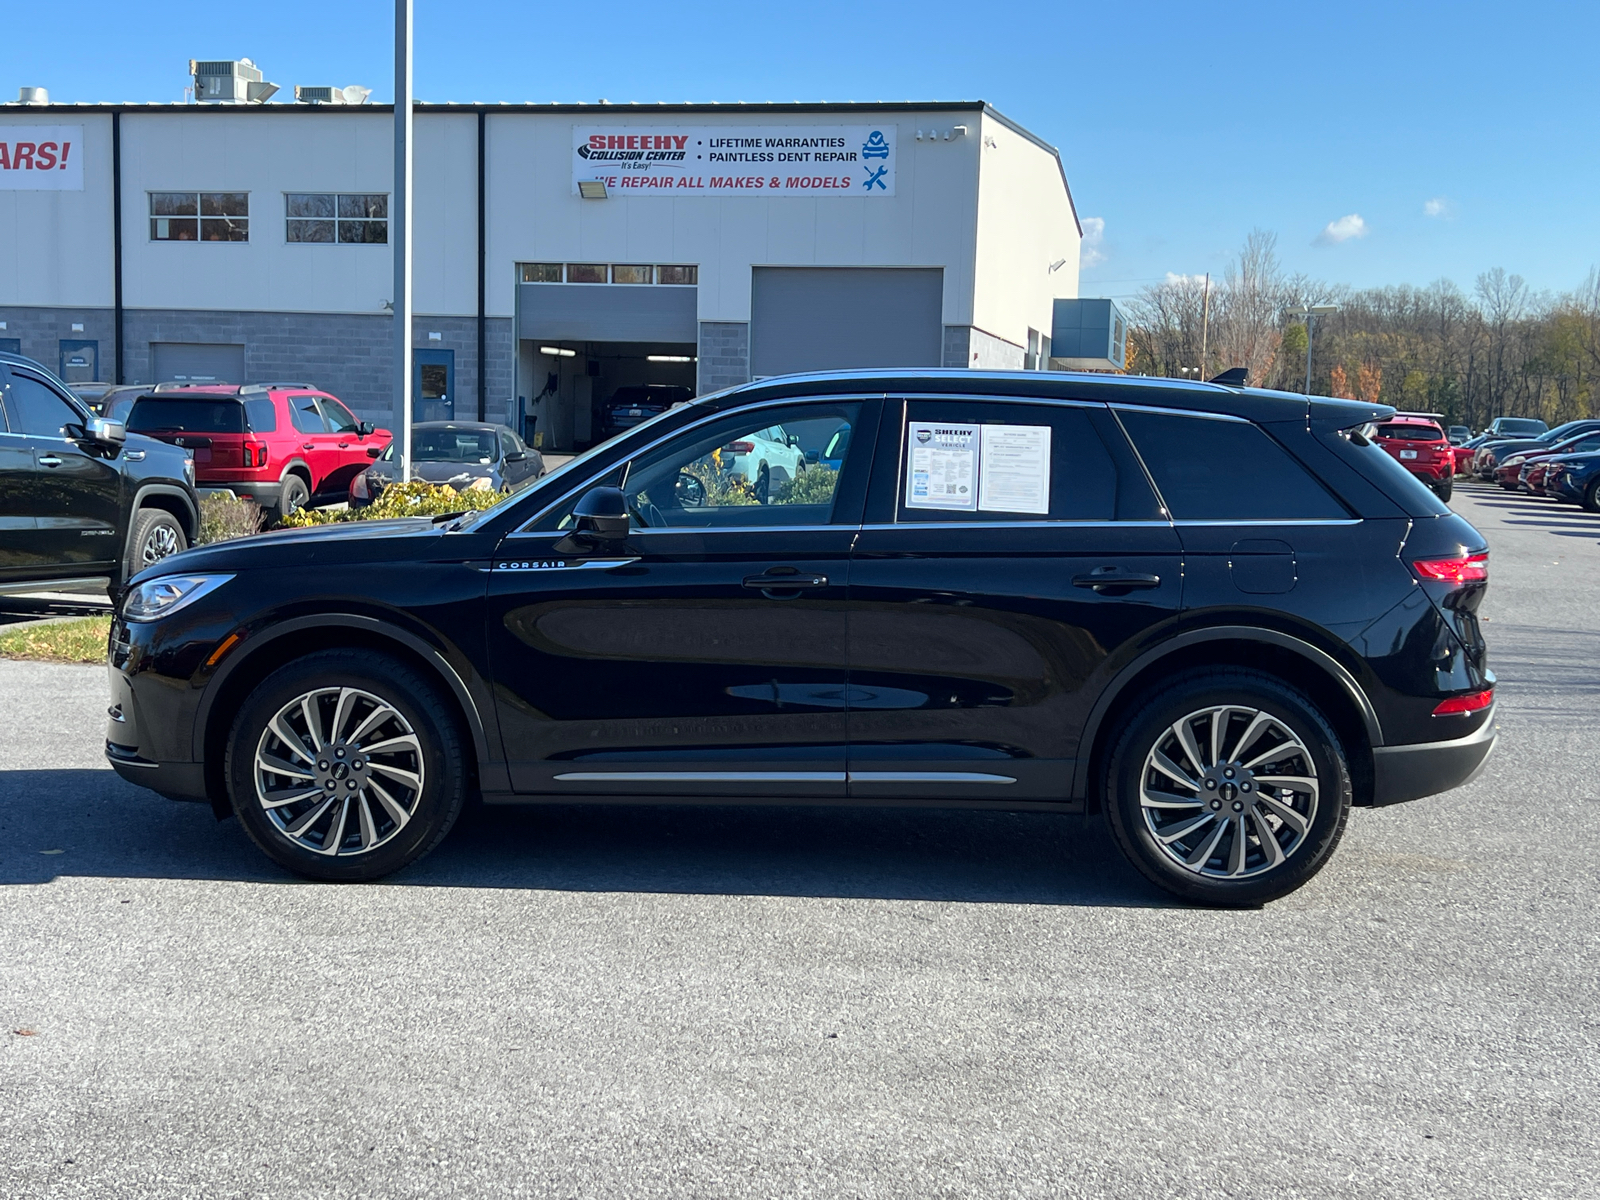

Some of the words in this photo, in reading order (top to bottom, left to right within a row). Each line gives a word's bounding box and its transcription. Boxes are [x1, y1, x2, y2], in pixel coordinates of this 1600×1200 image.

[589, 135, 689, 150] SHEEHY
[710, 138, 762, 148] LIFETIME
[765, 138, 845, 148] WARRANTIES
[0, 142, 71, 170] ARS!
[589, 150, 643, 160] COLLISION
[646, 151, 686, 160] CENTER
[710, 152, 774, 162] PAINTLESS
[778, 152, 811, 162] DENT
[814, 152, 857, 162] REPAIR
[621, 162, 632, 170] It's
[632, 162, 652, 171] Easy!
[595, 176, 617, 188] E
[621, 176, 674, 188] REPAIR
[676, 176, 704, 188] ALL
[709, 176, 765, 188] MAKES
[768, 176, 781, 188] &
[786, 176, 851, 188] MODELS
[934, 435, 972, 444] SELECT
